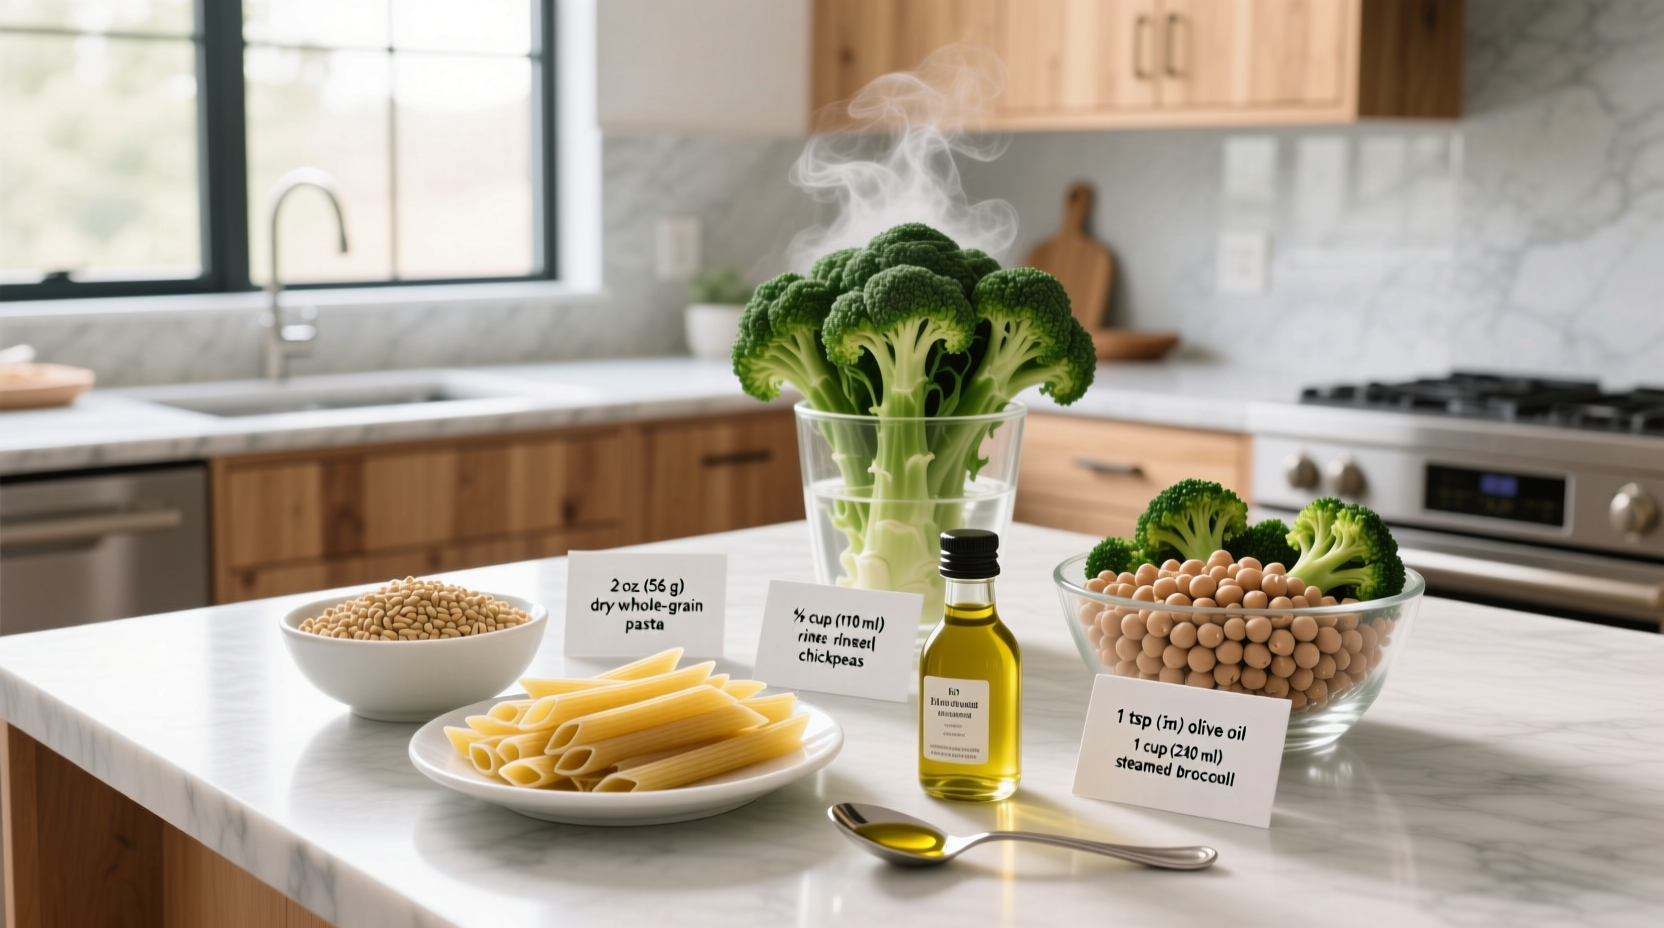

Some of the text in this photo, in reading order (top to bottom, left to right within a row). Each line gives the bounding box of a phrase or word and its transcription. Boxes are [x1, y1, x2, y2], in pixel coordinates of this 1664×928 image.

[610, 578, 686, 597] 2 oz (56 g)
[590, 597, 703, 616] dry whole-grain
[625, 618, 665, 634] pasta
[808, 613, 832, 629] cup
[861, 616, 885, 634] ml)
[798, 647, 864, 669] chickpeas
[1117, 708, 1124, 724] 1
[1128, 711, 1152, 731] tsp
[1187, 718, 1224, 739] olive
[1227, 725, 1247, 742] oil
[1134, 737, 1140, 751] 1
[1143, 742, 1168, 759] cup
[1200, 748, 1223, 767] ml)
[1115, 755, 1173, 777] steamed
